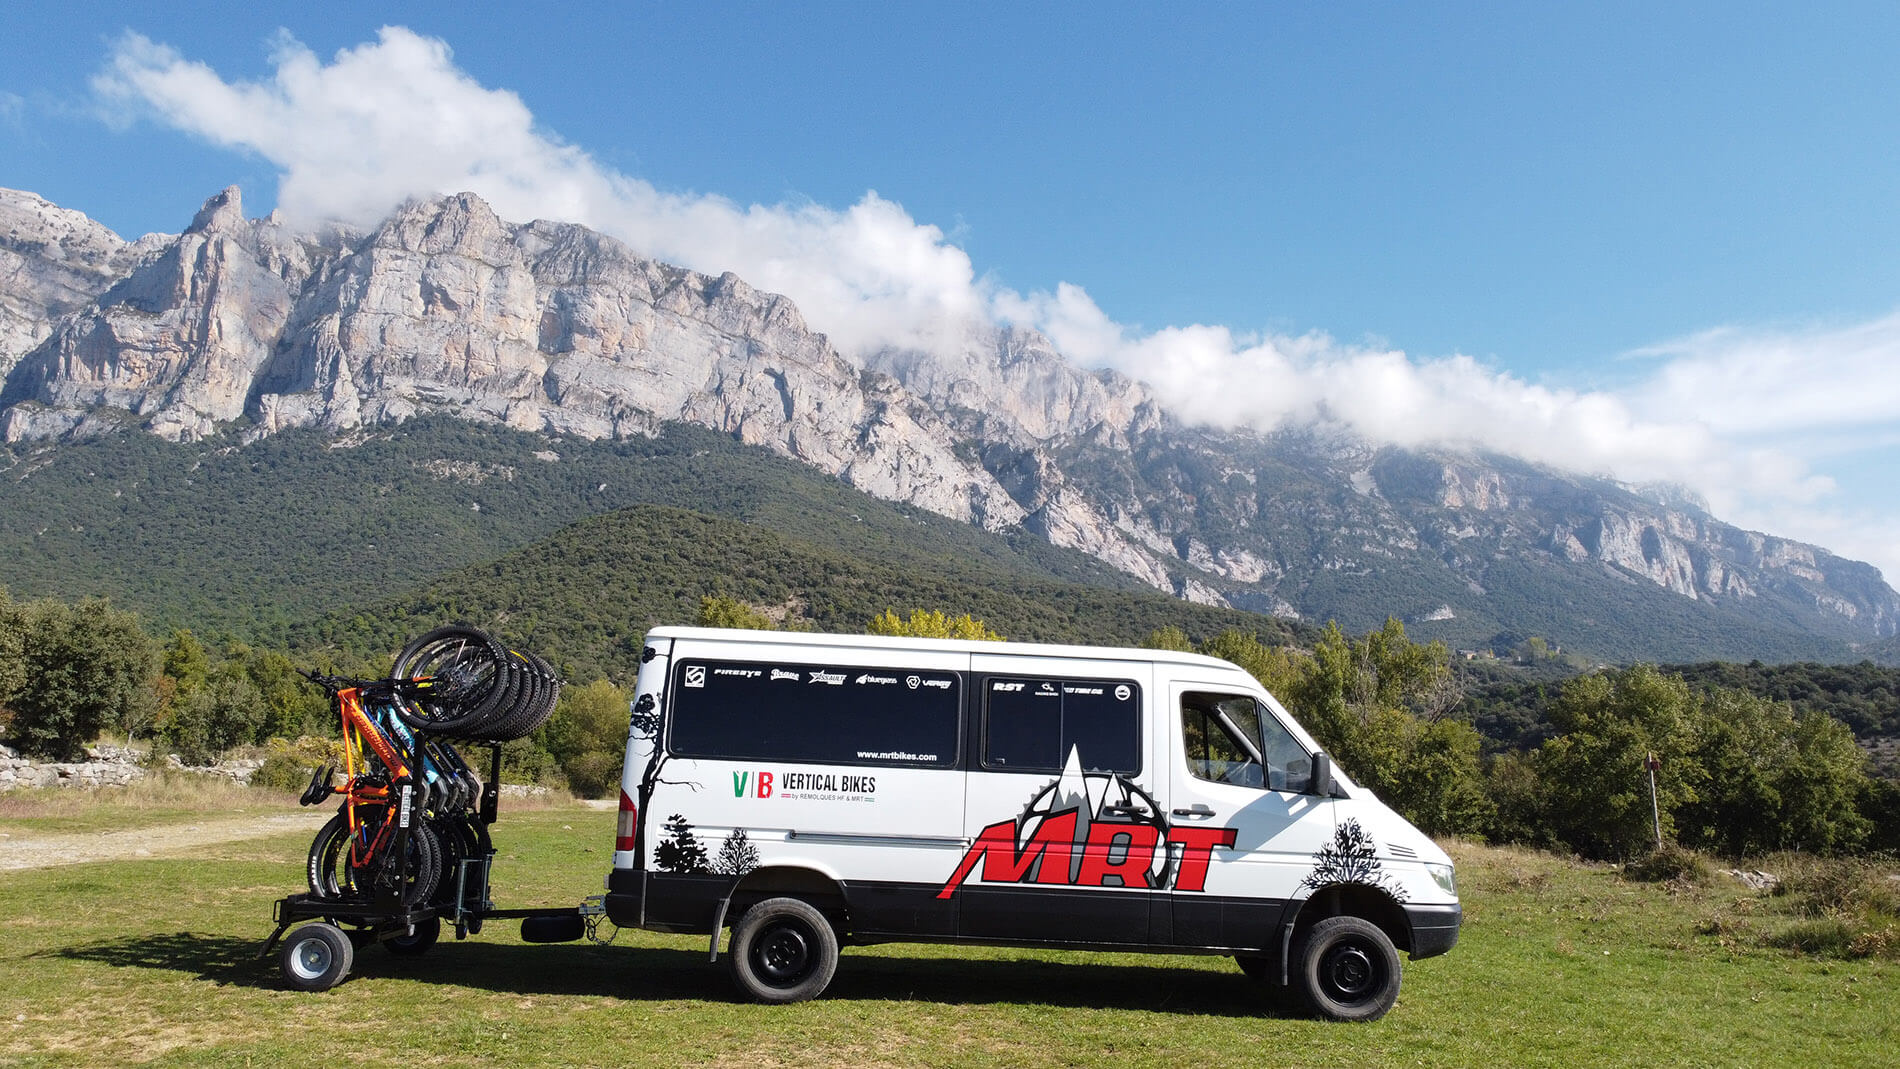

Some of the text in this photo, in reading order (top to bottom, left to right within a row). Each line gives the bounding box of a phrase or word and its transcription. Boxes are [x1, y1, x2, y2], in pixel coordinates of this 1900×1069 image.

[992, 682, 1026, 692] RST
[856, 751, 938, 762] www.mrtbikes.com
[782, 772, 876, 794] VERTICAL BIKES
[799, 793, 836, 801] REMOLQUES
[936, 806, 1238, 899] MRT
